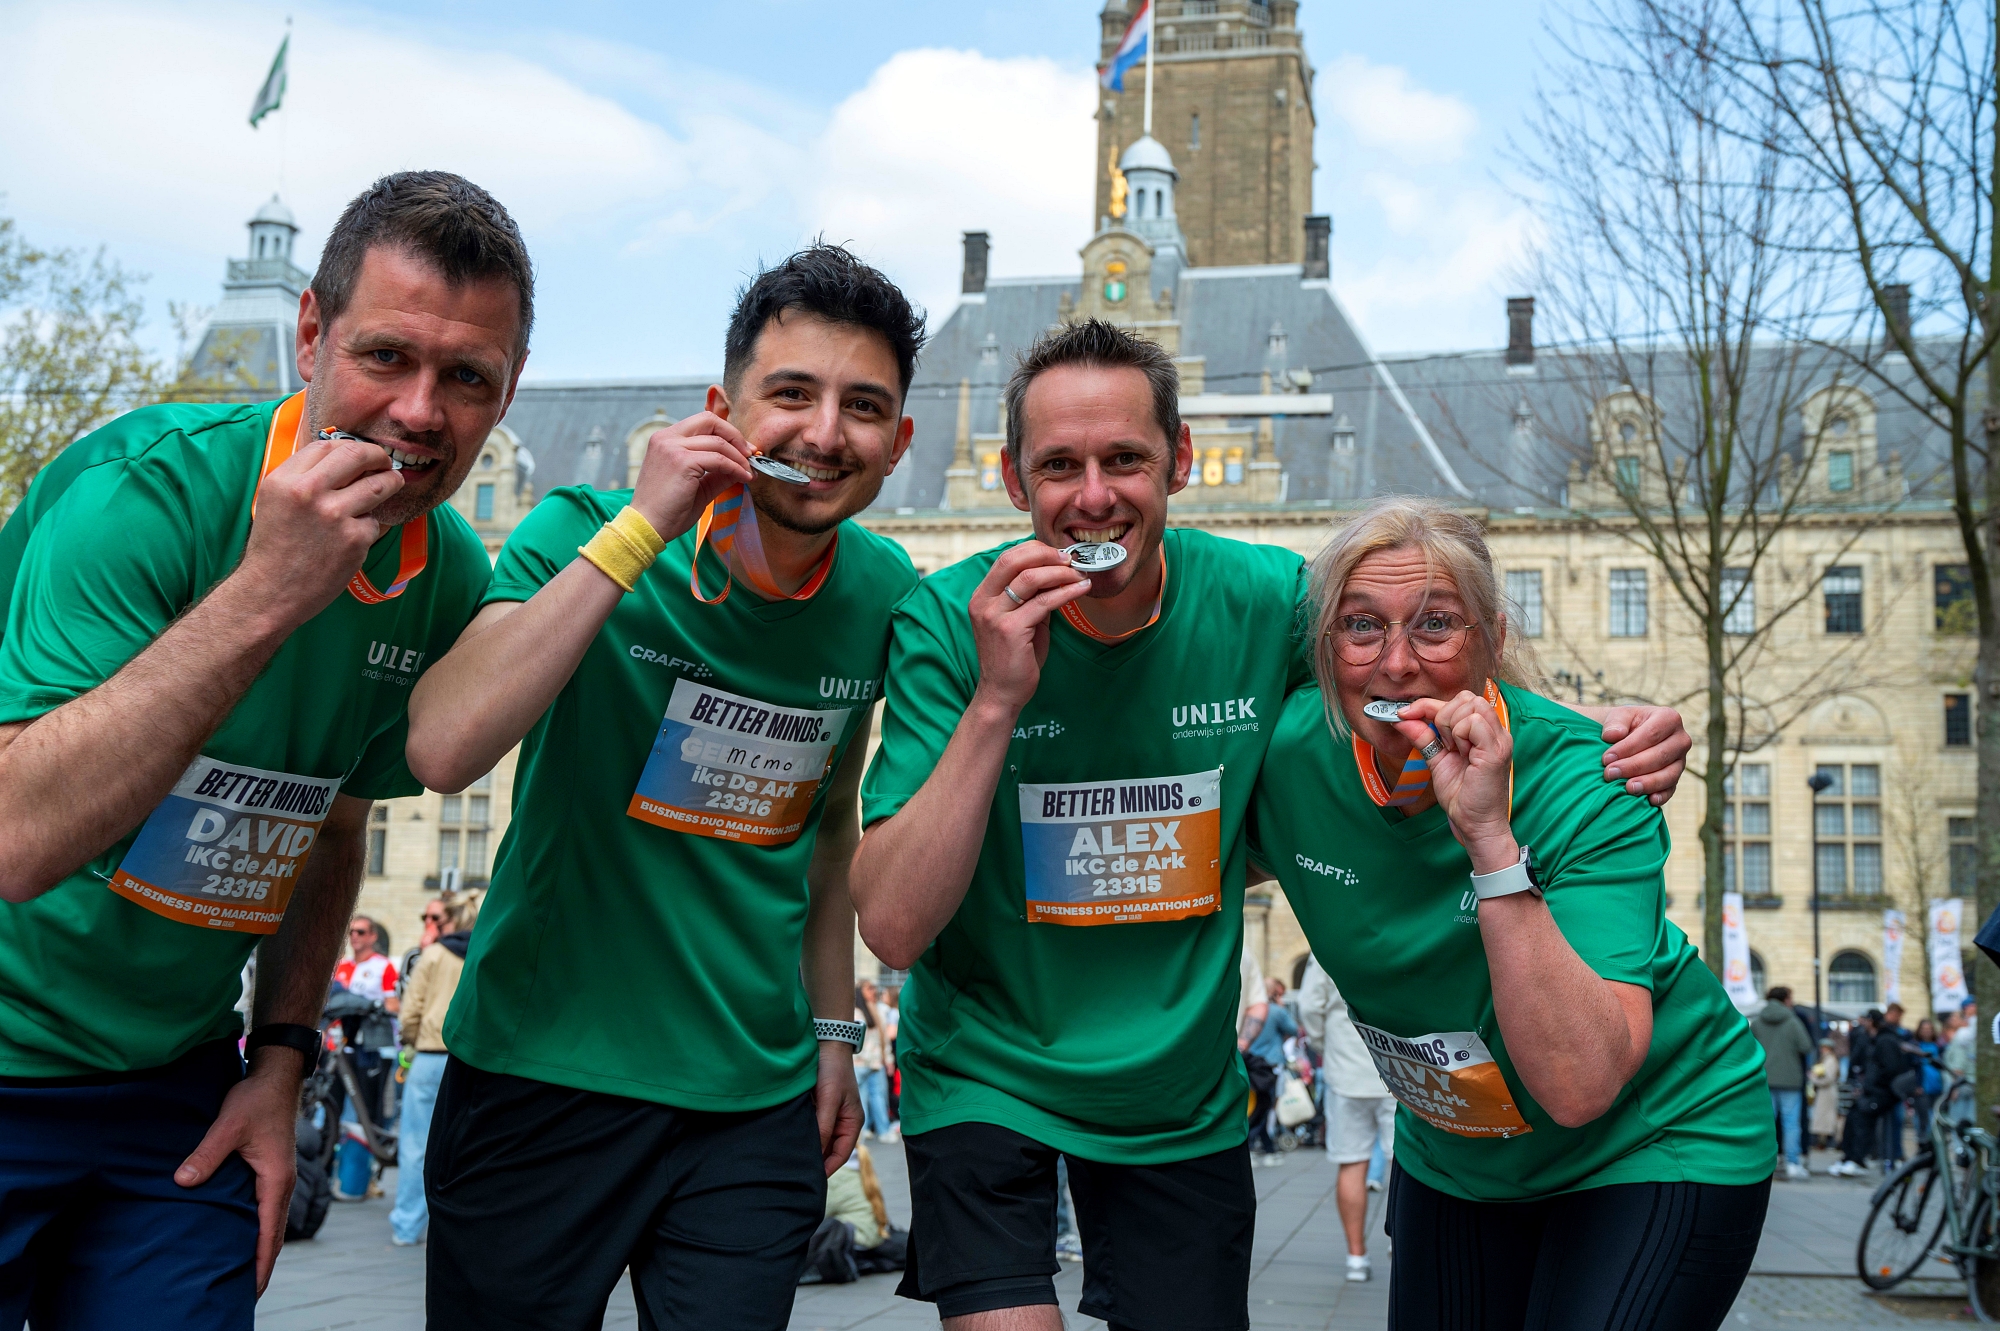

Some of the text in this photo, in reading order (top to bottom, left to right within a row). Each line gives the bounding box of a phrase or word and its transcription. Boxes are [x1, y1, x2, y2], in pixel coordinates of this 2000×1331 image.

[629, 644, 696, 672] CRAFT
[690, 692, 823, 743] BETTER MINDS
[1012, 725, 1046, 739] AFT
[1172, 727, 1214, 740] onderwijs
[1226, 722, 1259, 734] opvang
[194, 768, 330, 815] BETTER MINDS
[691, 765, 798, 799] ikc De Ark
[705, 791, 772, 817] 23316
[1042, 782, 1183, 818] BETTER MINDS
[185, 808, 315, 857] DAVID
[640, 800, 700, 825] BUSINESS
[700, 815, 724, 828] DUO
[725, 820, 784, 836] MARATHON
[1068, 820, 1182, 857] ALEX
[184, 845, 297, 878] IKC de Ark
[1065, 852, 1186, 876] IKC de Ark
[1295, 853, 1344, 880] CRAFT
[201, 875, 271, 900] 23315
[1092, 875, 1162, 896] 23315
[124, 878, 192, 912] BUSINESS
[193, 903, 220, 917] DUO
[221, 908, 280, 923] MARATHON
[1035, 894, 1215, 916] BUSINESS DUO MARATHON 2025
[1354, 1024, 1449, 1066] TTER MINDS
[1371, 1050, 1450, 1092] VIVY
[1400, 1089, 1456, 1118] 23316
[1402, 1081, 1429, 1098] De
[1433, 1089, 1471, 1107] Ark
[1430, 1116, 1490, 1132] MARATHON
